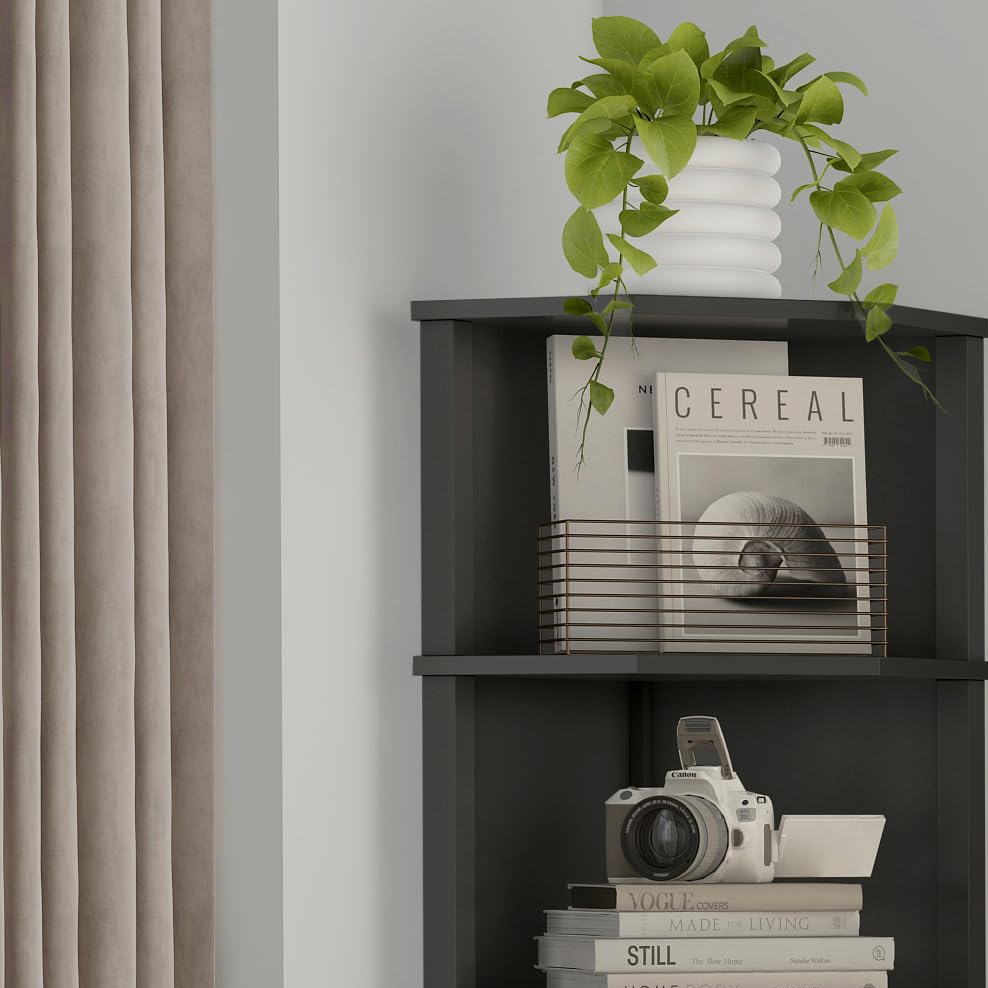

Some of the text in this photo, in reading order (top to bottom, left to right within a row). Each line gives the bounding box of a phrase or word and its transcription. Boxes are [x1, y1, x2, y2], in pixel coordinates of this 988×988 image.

[675, 386, 854, 423] CEREAL
[629, 891, 729, 911] VOGUE COVERS
[669, 918, 721, 932] MADE
[749, 916, 809, 931] LIVING
[627, 945, 676, 966] STILL
[692, 957, 704, 965] The
[706, 957, 721, 965] Slow
